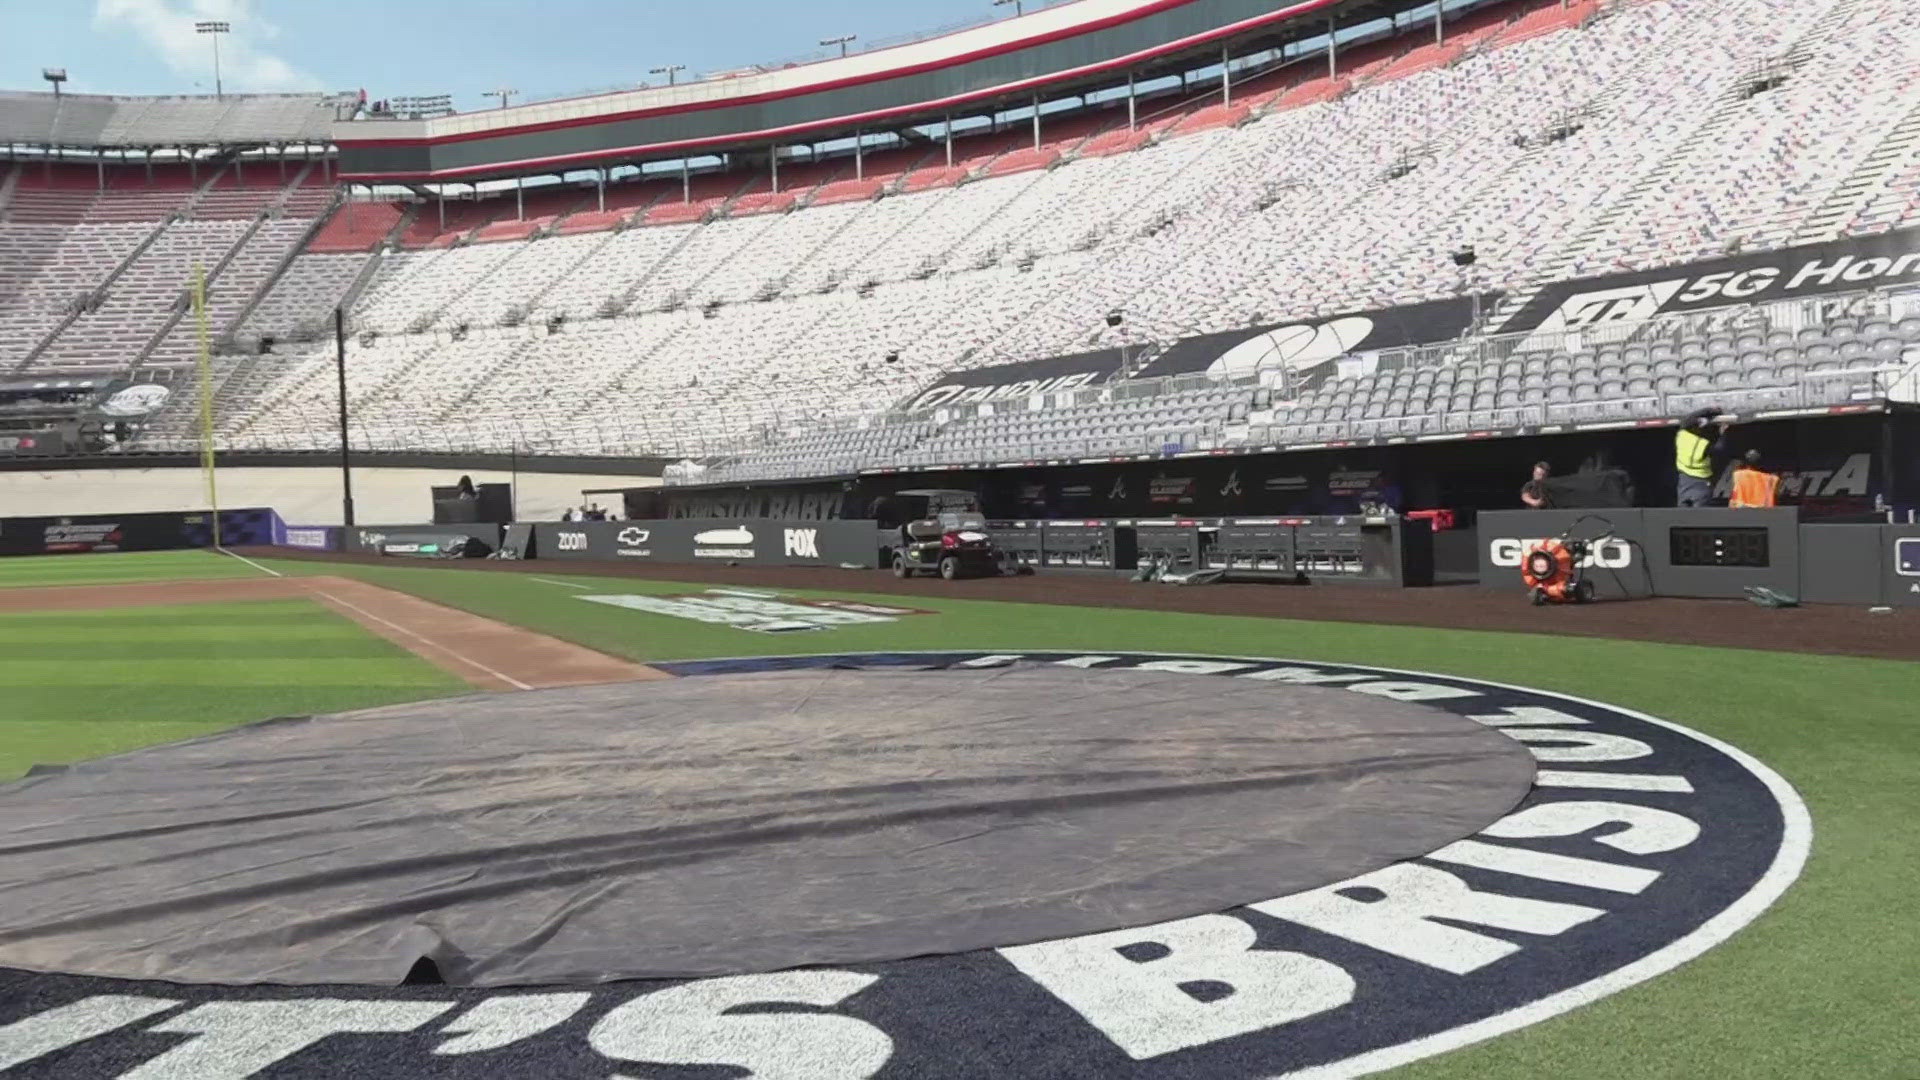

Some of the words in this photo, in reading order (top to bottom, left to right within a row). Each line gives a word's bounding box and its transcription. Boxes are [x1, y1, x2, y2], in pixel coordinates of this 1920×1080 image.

[1679, 267, 1780, 302] 5G
[1712, 453, 1871, 498] ANTA
[783, 528, 819, 558] FOX
[1490, 537, 1631, 569] GCO
